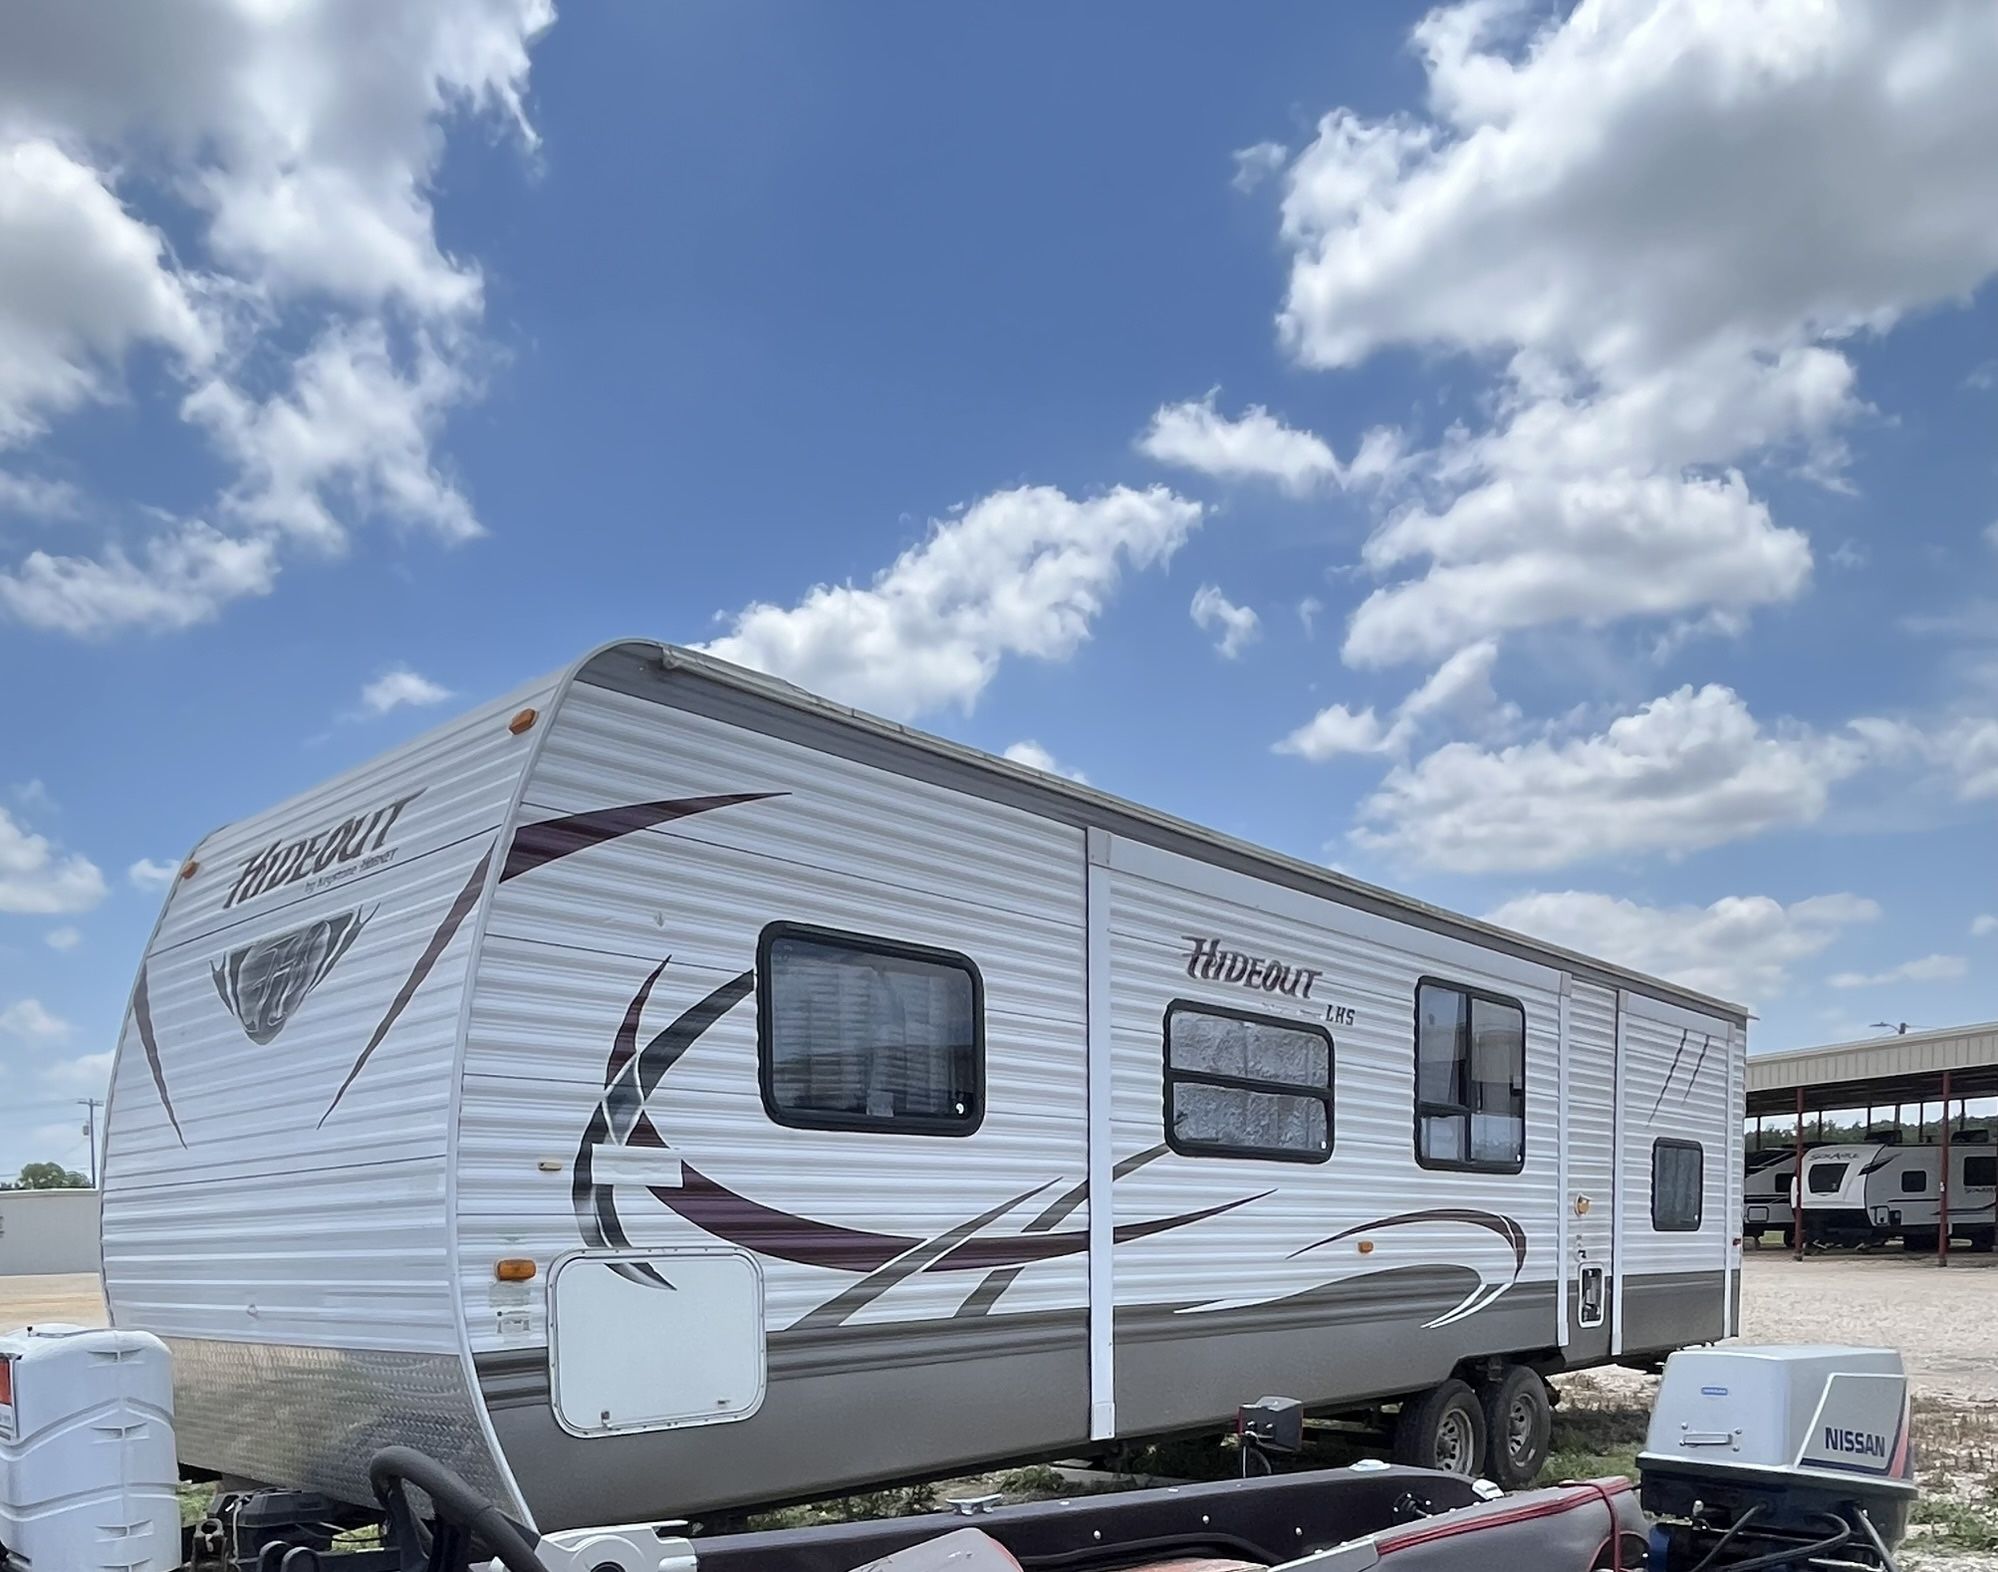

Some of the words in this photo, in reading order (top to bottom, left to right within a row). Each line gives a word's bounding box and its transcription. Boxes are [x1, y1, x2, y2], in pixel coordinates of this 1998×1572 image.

[222, 786, 428, 909] HIDEOUT
[1181, 935, 1323, 999] HIDEOUT
[1325, 1004, 1356, 1026] LHS
[1825, 1427, 1885, 1457] NISSAN
